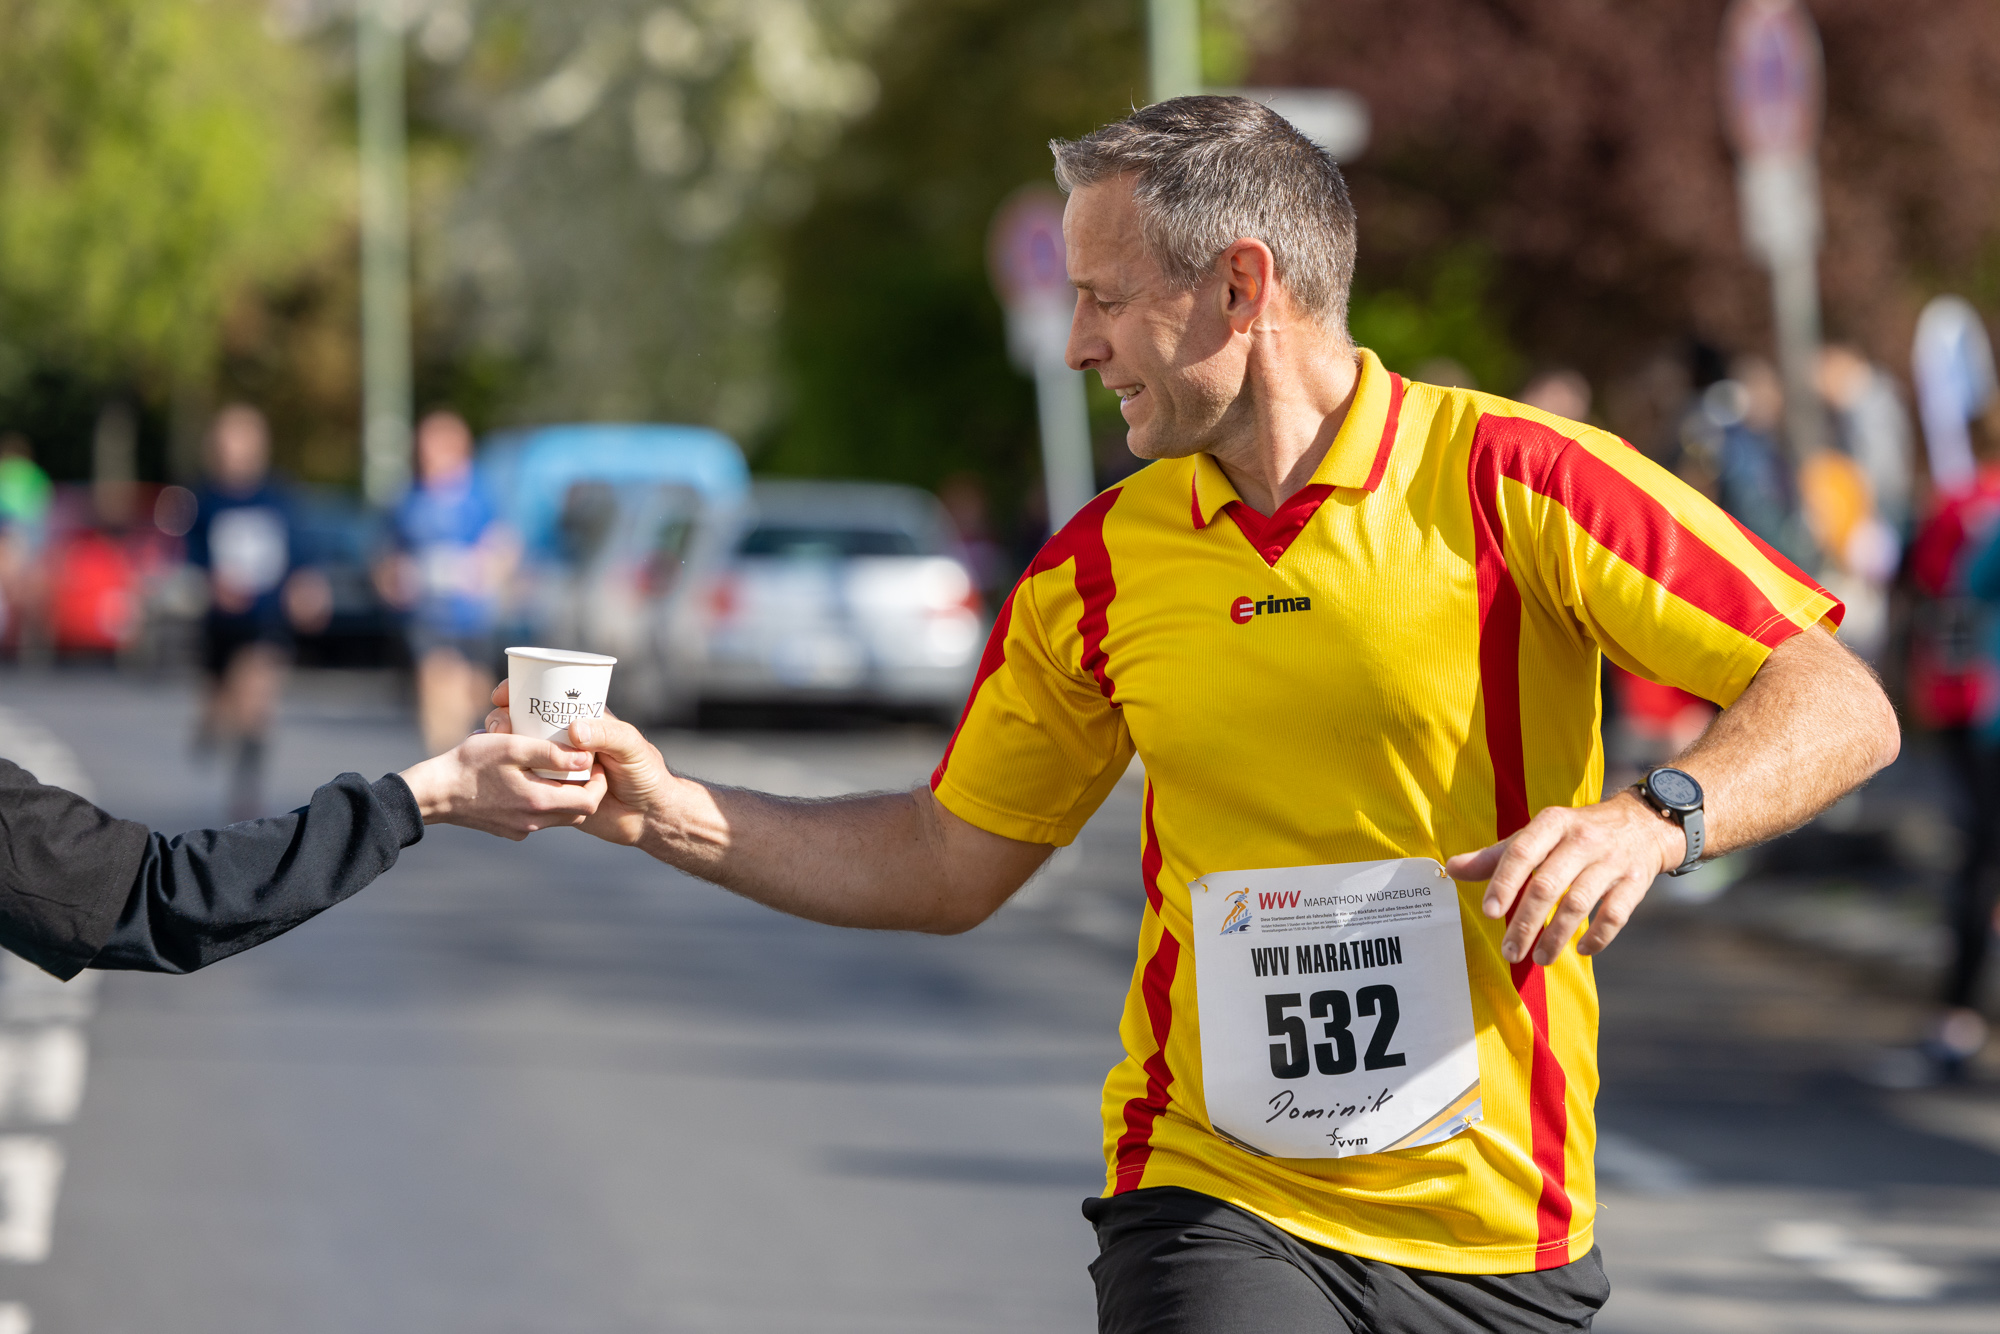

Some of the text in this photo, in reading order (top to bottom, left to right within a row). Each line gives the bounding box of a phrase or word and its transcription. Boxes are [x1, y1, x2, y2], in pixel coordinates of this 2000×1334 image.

[1230, 595, 1311, 625] erima
[529, 697, 603, 718] RESIDENZ
[541, 713, 587, 725] QUEL
[1258, 887, 1431, 910] WVV MARATHON WÜRZBURG
[1251, 936, 1403, 977] WVV MARATHON
[1265, 984, 1406, 1080] 532
[1265, 1088, 1393, 1124] Dominik
[1338, 1136, 1368, 1148] vvm
